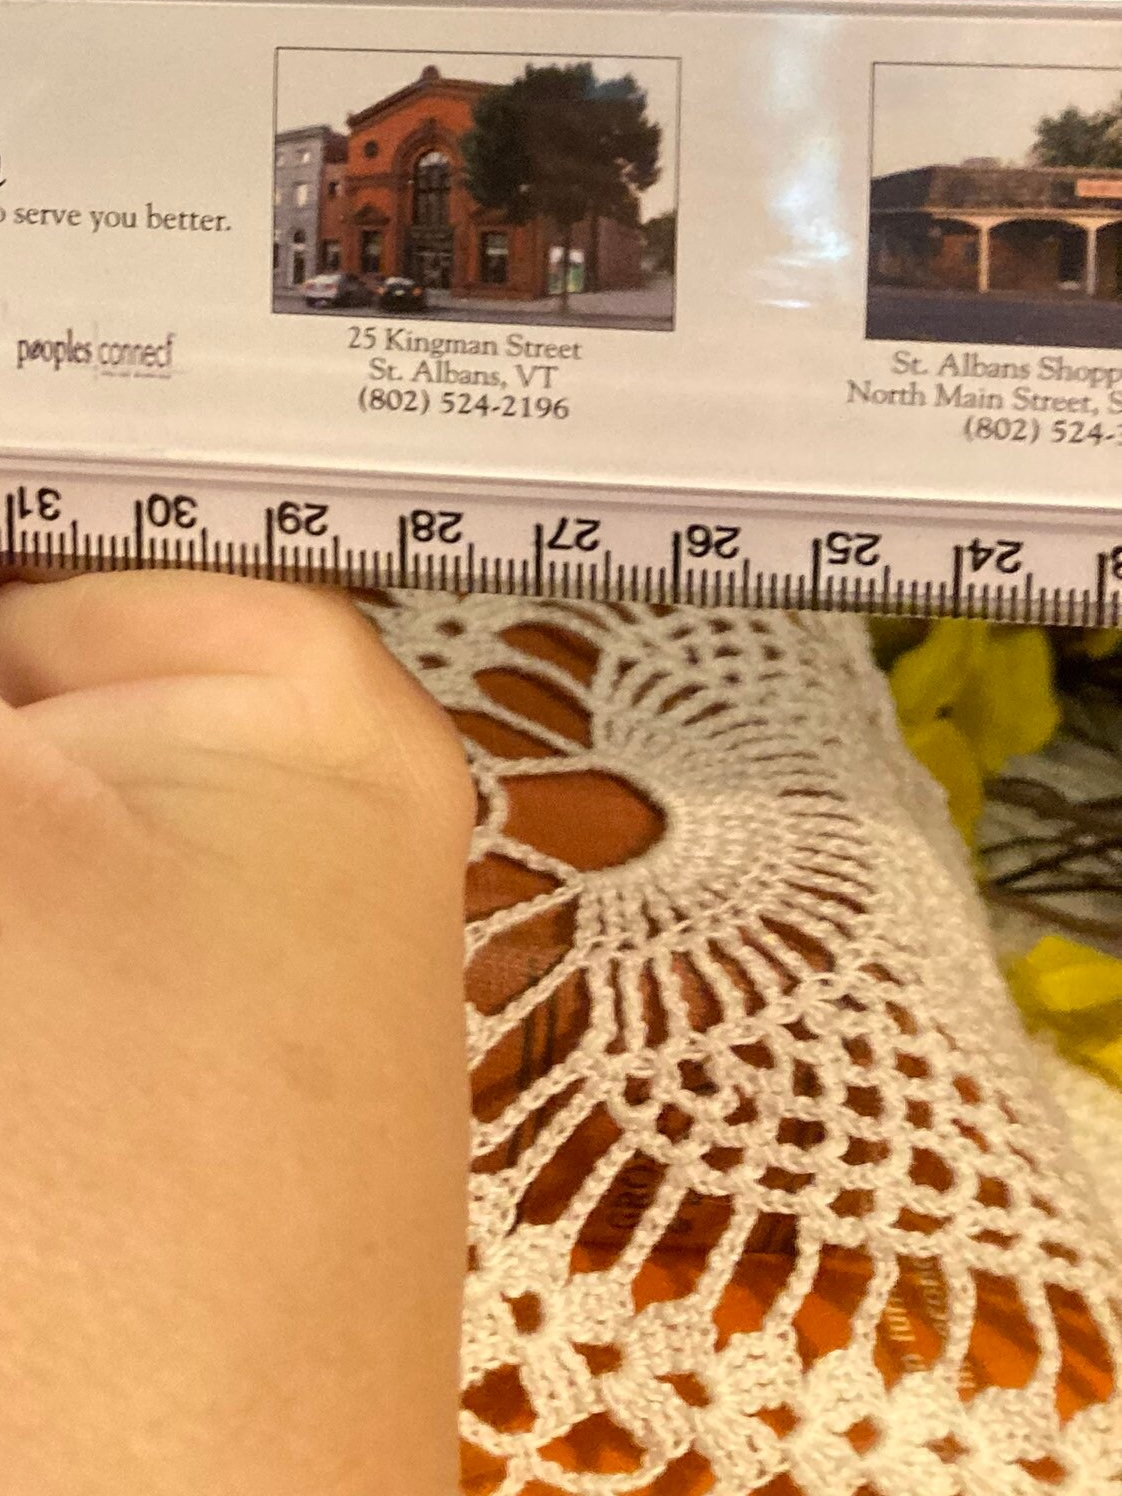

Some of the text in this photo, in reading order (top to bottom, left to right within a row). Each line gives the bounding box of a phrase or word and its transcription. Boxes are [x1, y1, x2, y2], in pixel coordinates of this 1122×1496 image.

[13, 206, 82, 226] serve
[90, 208, 138, 233] you
[145, 202, 232, 232] better.
[347, 325, 583, 360] 25 Kingman Street
[368, 357, 559, 391] St. Albans, VT
[890, 350, 928, 375] St.
[938, 352, 1031, 380] Albans
[358, 385, 570, 421] (802) 524-2196
[846, 379, 926, 407] North
[934, 382, 1003, 410] Main
[1013, 386, 1099, 416] Street,
[964, 415, 1122, 446] (802) 524-
[17, 486, 62, 522] 31
[147, 493, 198, 529] 30
[278, 501, 329, 537] 29
[410, 509, 464, 544] 28
[547, 517, 601, 552] 27
[686, 524, 741, 560] 26
[825, 530, 882, 566] 25
[967, 537, 1024, 573] 24
